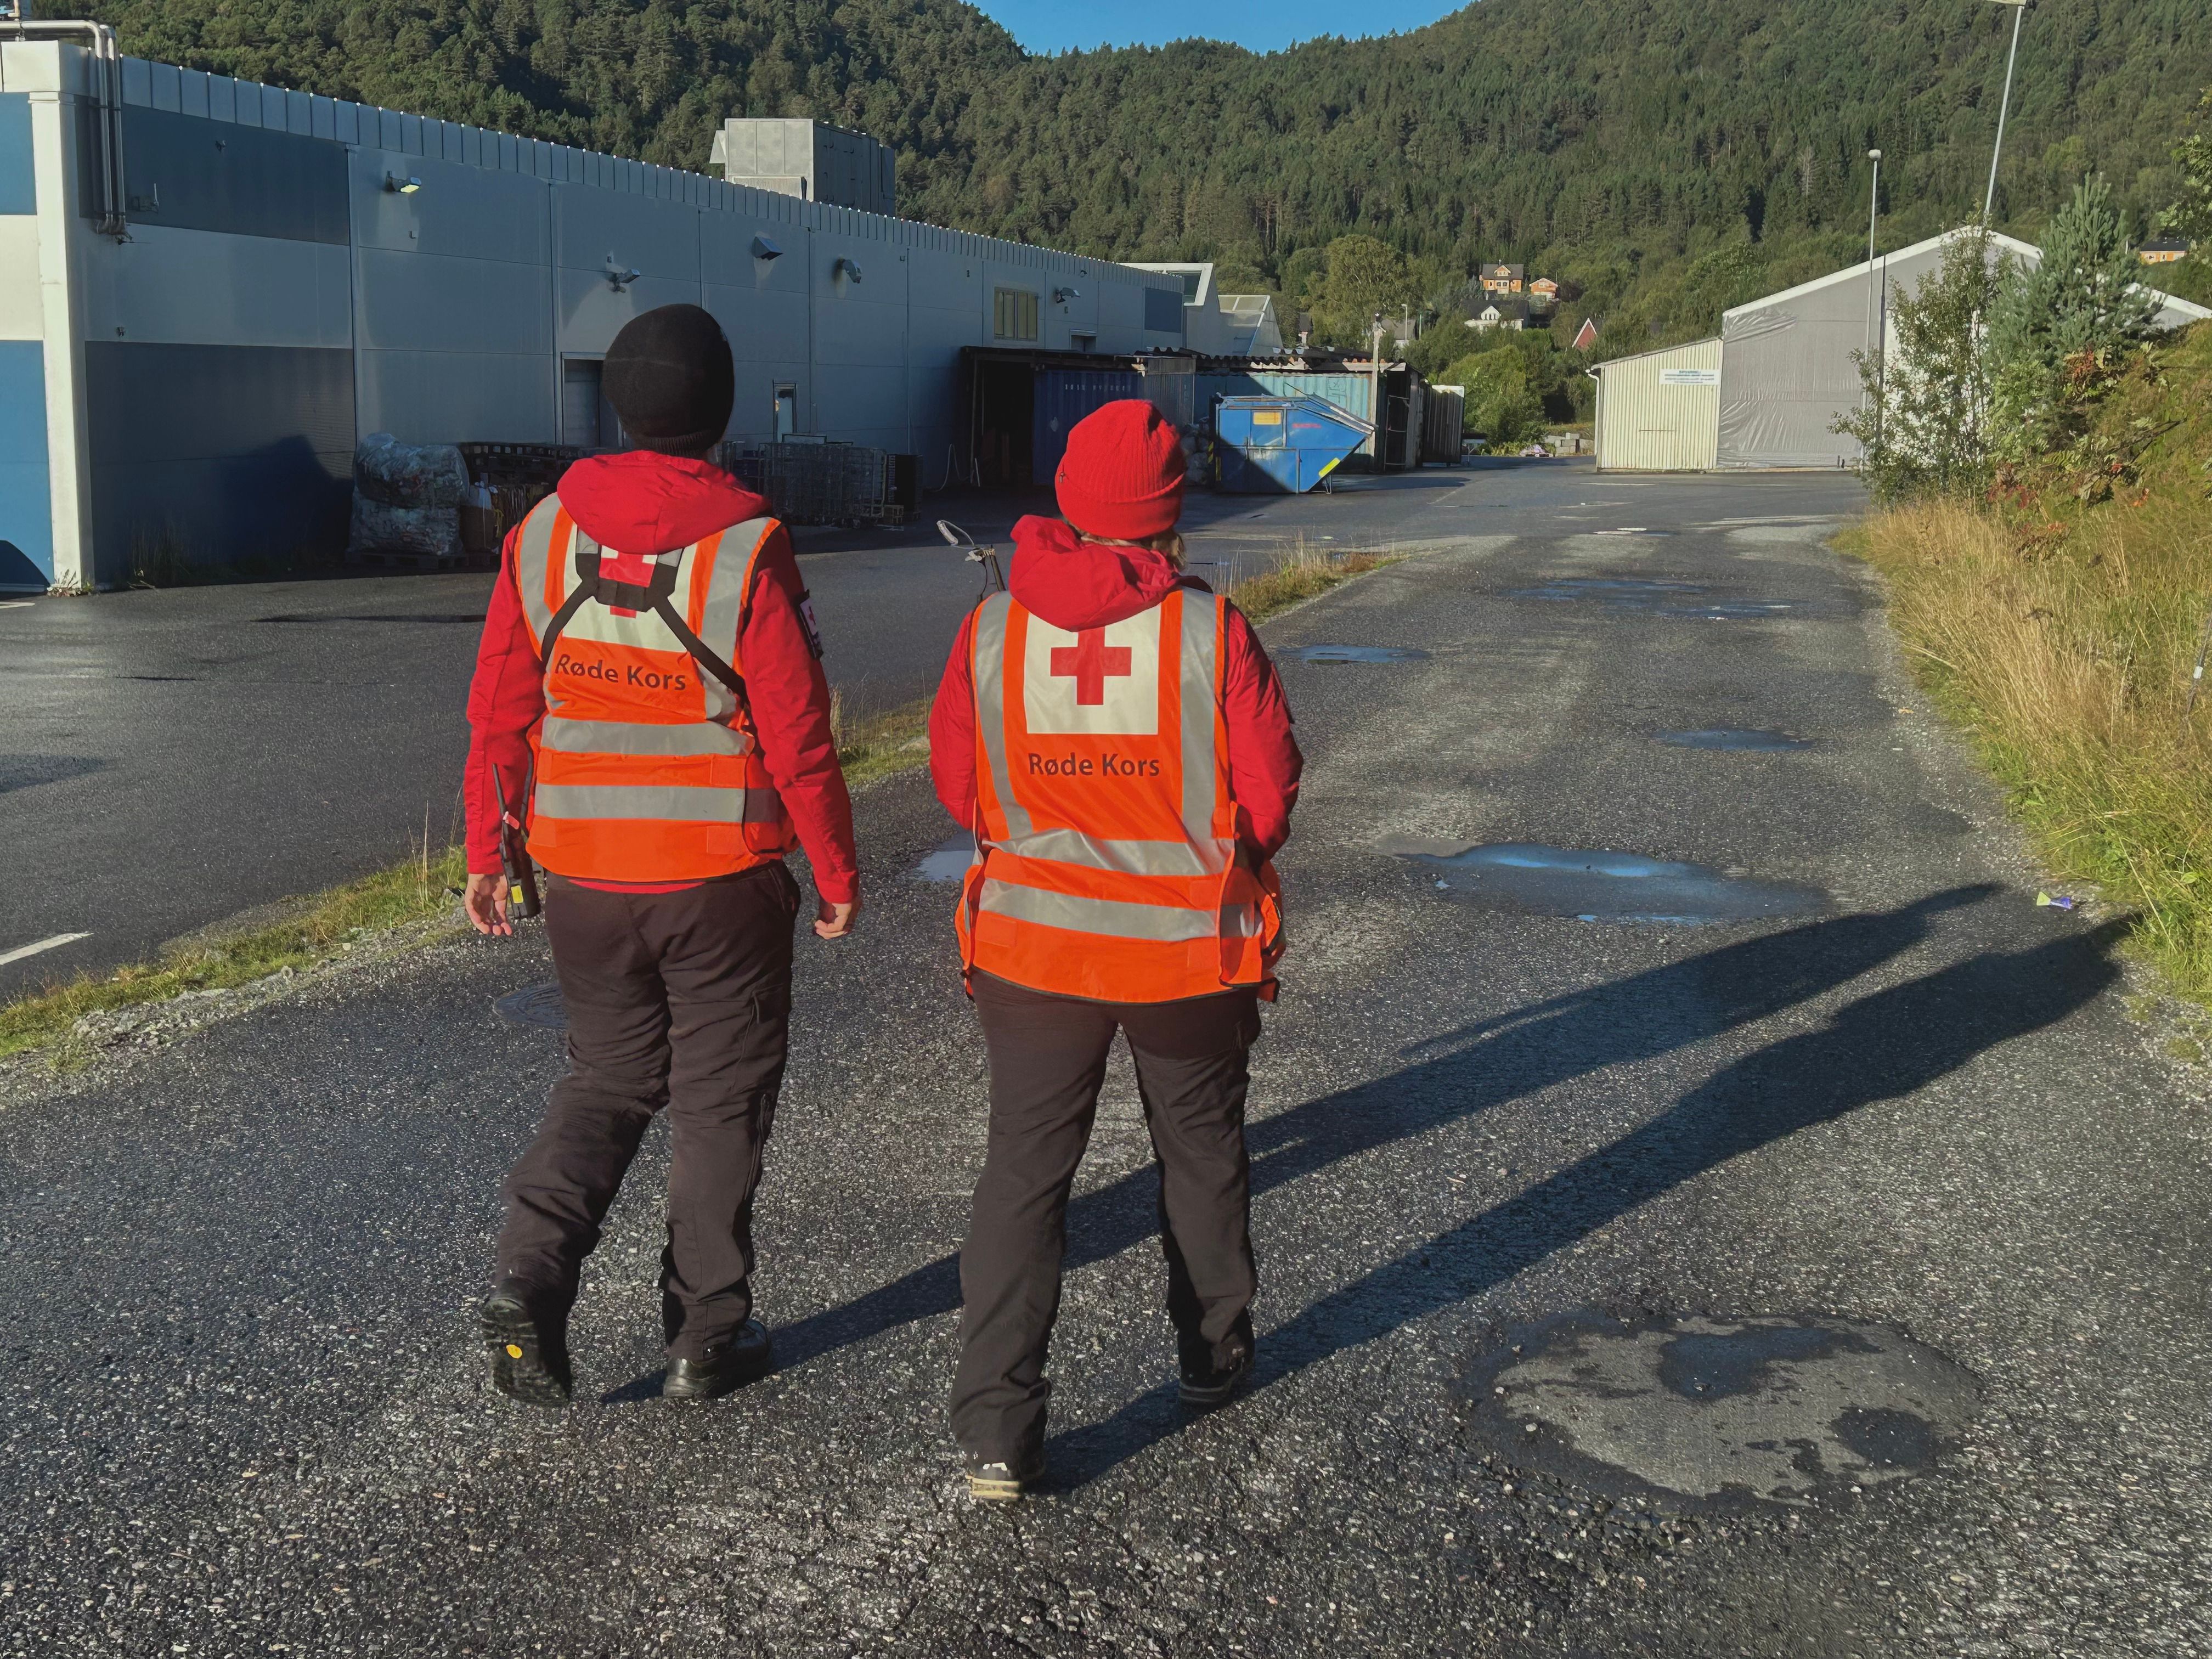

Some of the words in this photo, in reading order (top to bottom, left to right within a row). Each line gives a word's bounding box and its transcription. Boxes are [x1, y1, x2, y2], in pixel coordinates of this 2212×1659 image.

[555, 653, 619, 683] Røde
[627, 665, 686, 691] Kors
[1028, 752, 1093, 776] Røde
[1102, 753, 1160, 777] Kors
